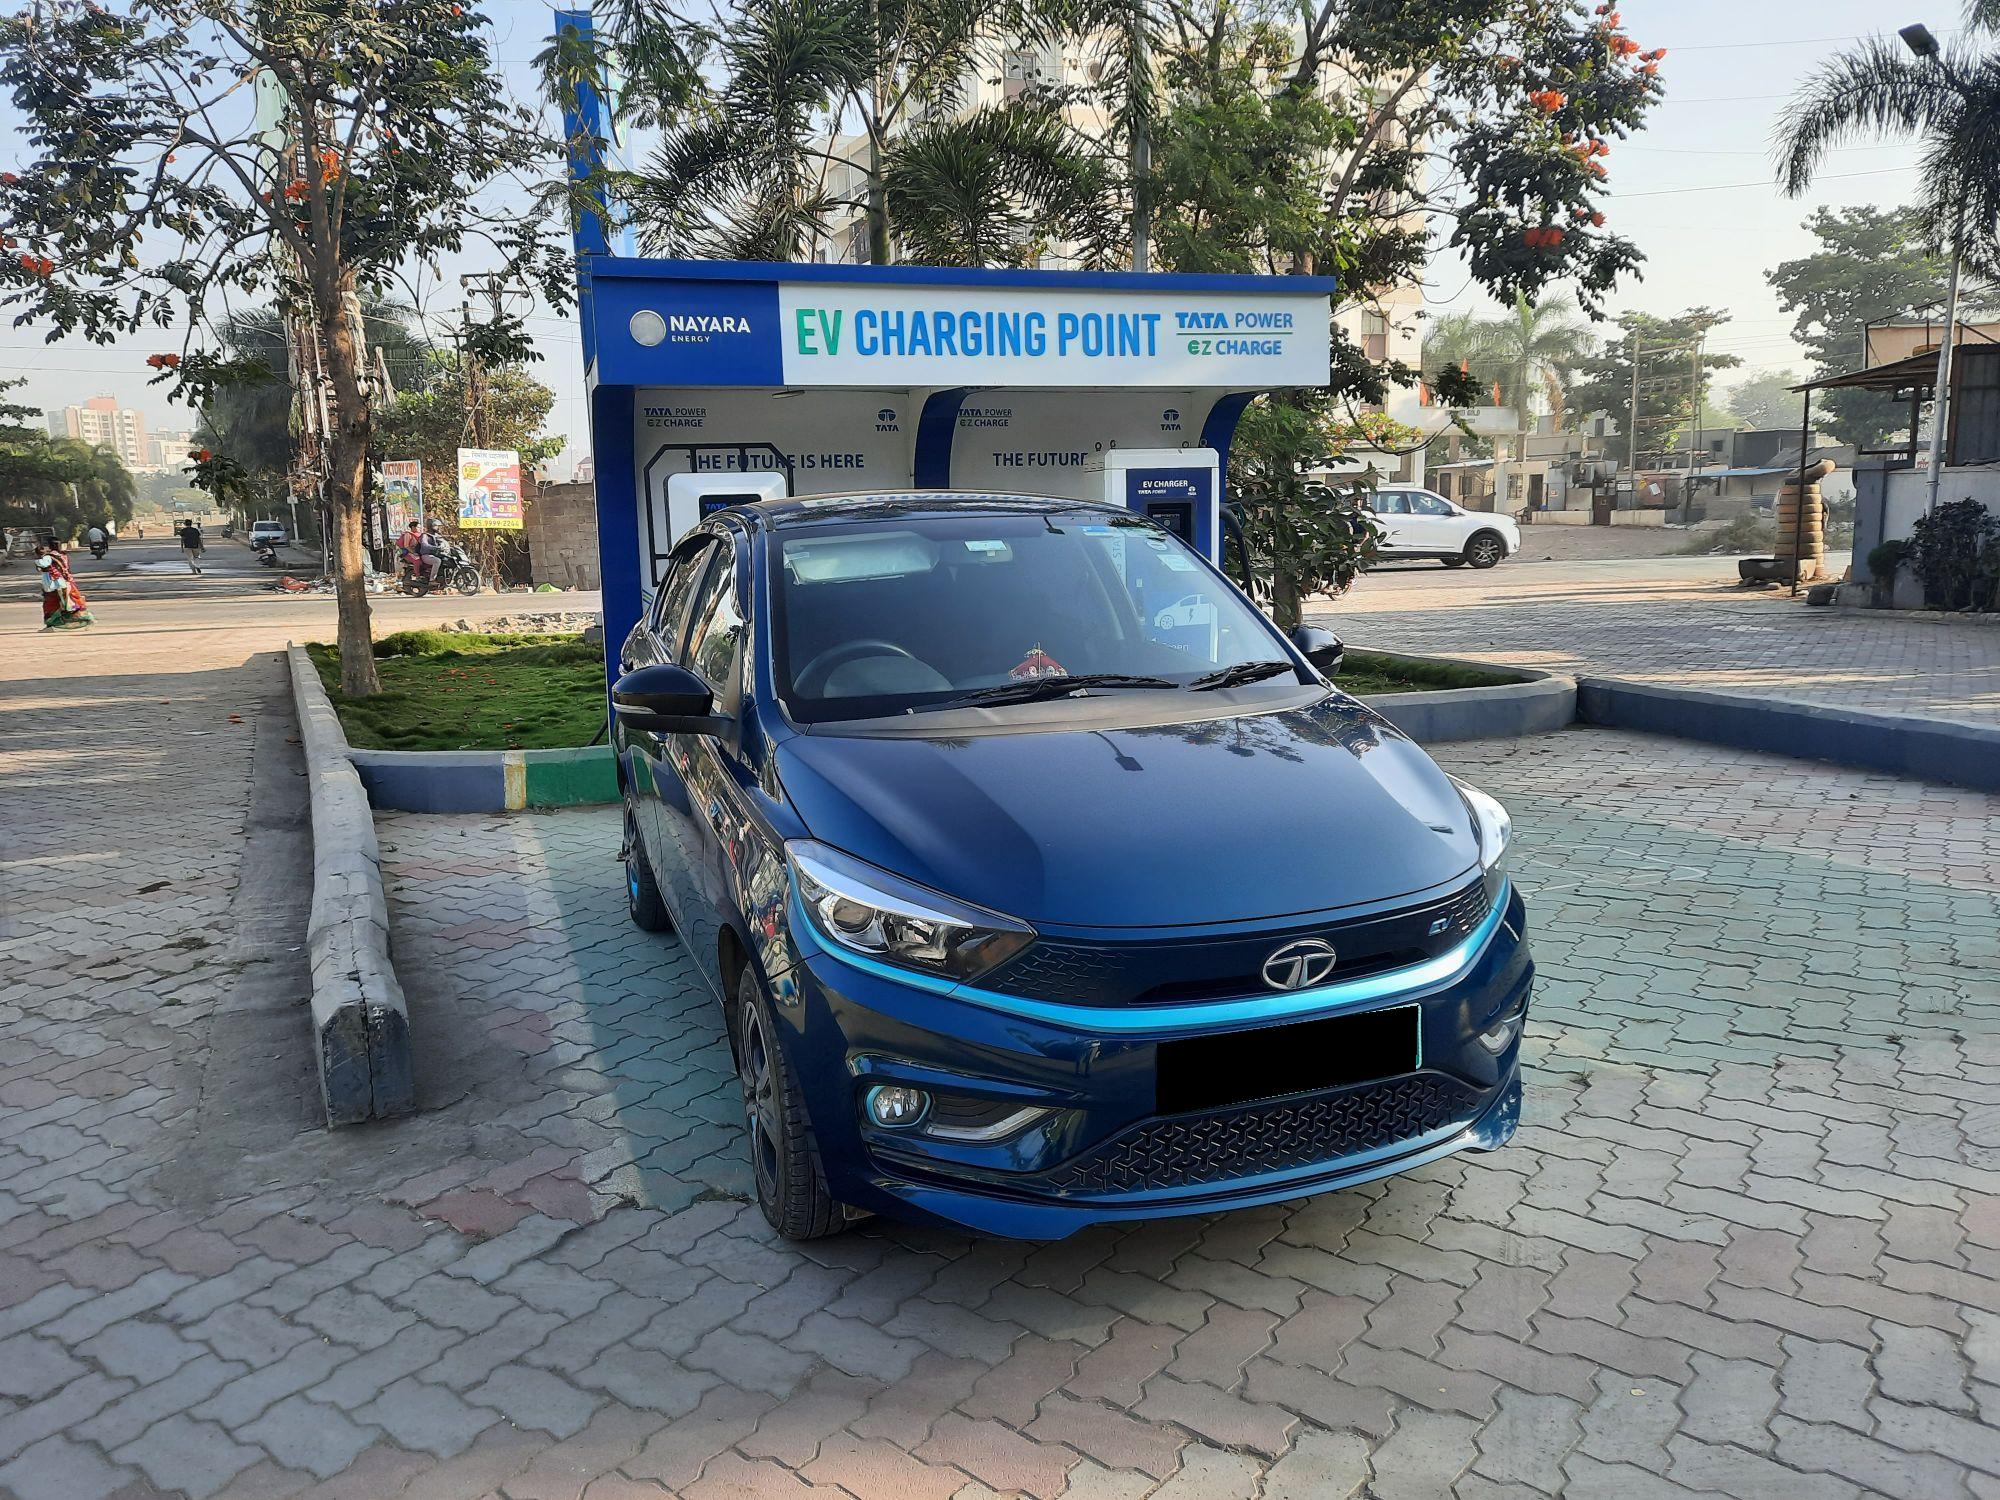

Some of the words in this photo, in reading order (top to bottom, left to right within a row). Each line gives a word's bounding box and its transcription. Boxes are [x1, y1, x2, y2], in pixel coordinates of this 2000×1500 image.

[669, 315, 751, 333] NAYARA
[1175, 312, 1229, 329] TATA
[1235, 312, 1293, 328] POWER
[795, 308, 843, 356] EV
[855, 309, 1046, 357] CHARGING
[1057, 312, 1161, 357] POINT
[1215, 340, 1282, 356] CHARGE
[644, 407, 672, 416] TATA
[675, 407, 707, 416] POWER
[958, 408, 982, 416] TATA
[985, 408, 1012, 416] POWER
[663, 419, 704, 427] CHARGE
[875, 424, 899, 432] TATA
[974, 419, 1009, 427] CHARGE
[801, 454, 816, 469] IS
[821, 454, 865, 469] HERE
[992, 452, 1024, 467] THE
[384, 463, 405, 476] VICTORY
[1143, 480, 1153, 488] EV
[1153, 480, 1188, 488] CHARGER
